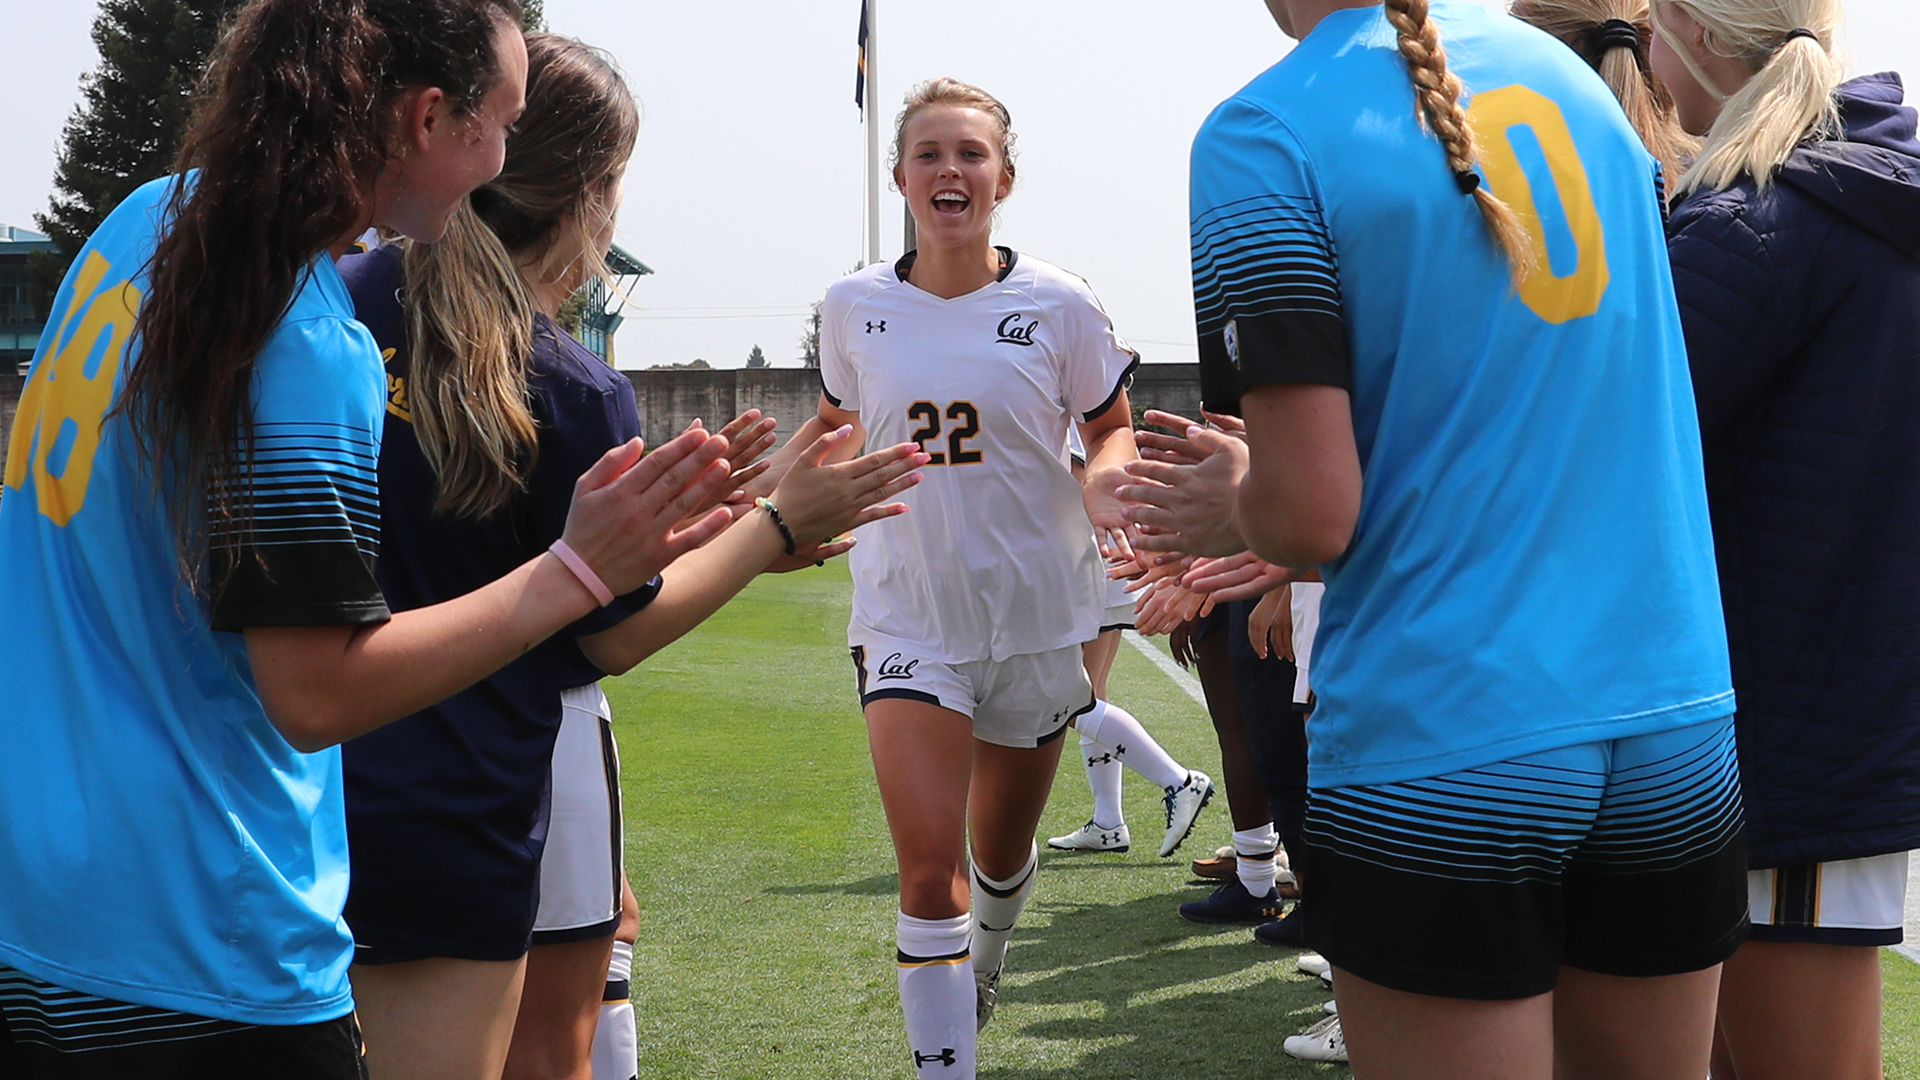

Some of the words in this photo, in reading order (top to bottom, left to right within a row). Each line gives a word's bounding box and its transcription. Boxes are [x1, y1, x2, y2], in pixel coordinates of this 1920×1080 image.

[1467, 83, 1611, 325] 0
[995, 313, 1039, 346] Cal
[906, 400, 984, 467] 22
[876, 652, 919, 683] Cal
